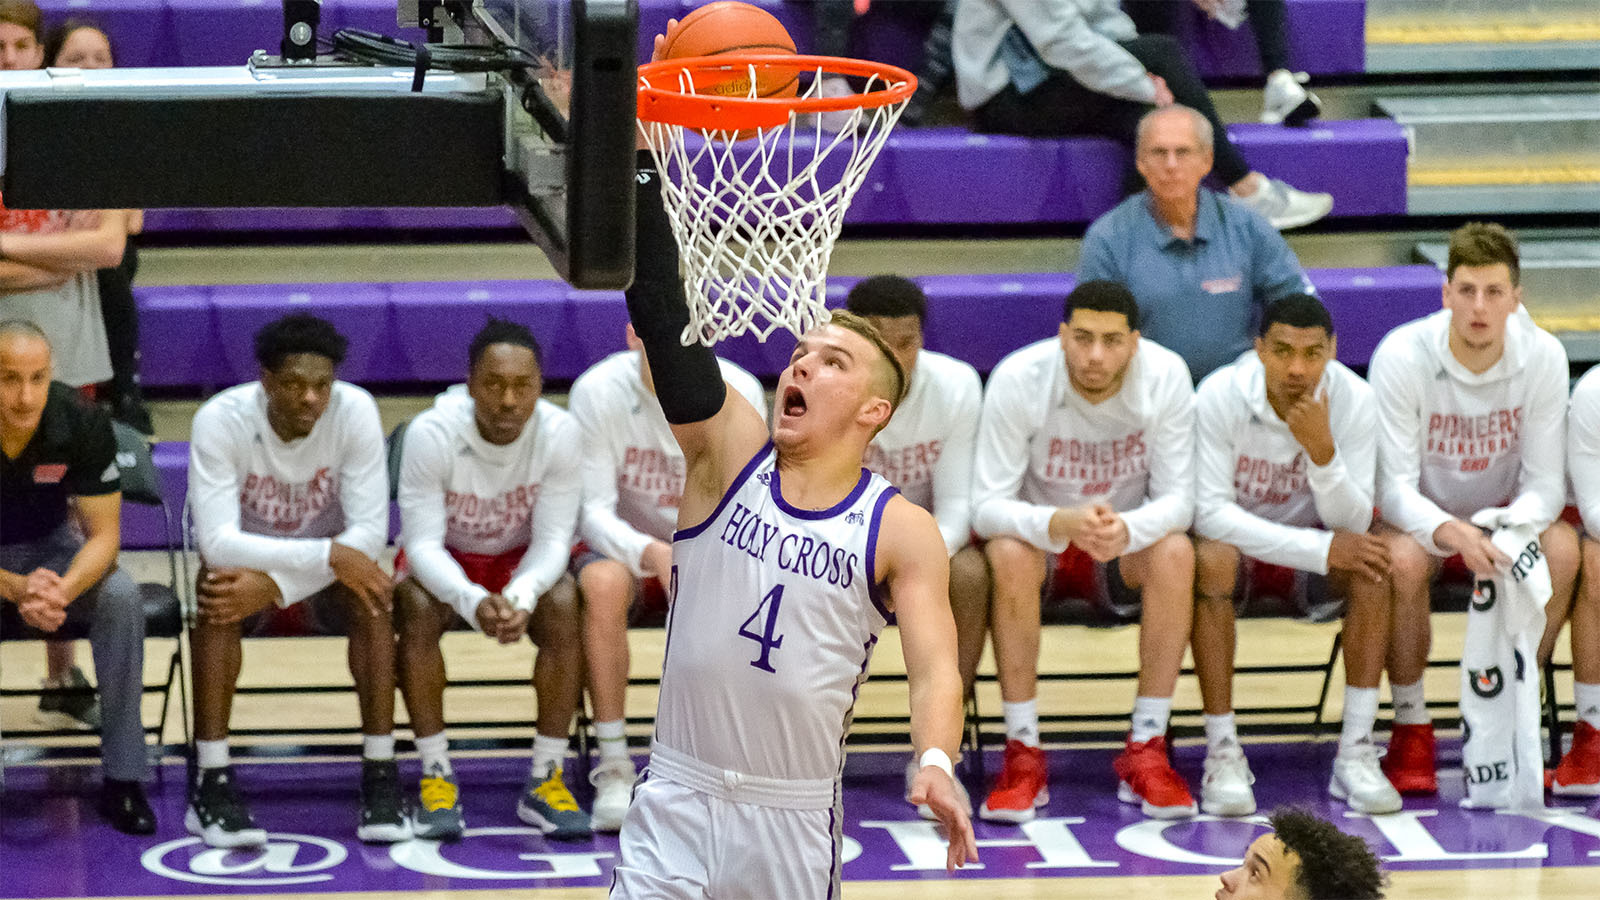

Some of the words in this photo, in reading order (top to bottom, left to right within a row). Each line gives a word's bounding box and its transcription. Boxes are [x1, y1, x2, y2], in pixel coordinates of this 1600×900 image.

[1049, 429, 1146, 465] PIONEERS
[720, 502, 779, 562] HOLY
[777, 533, 858, 590] CROSS
[737, 583, 785, 674] 4
